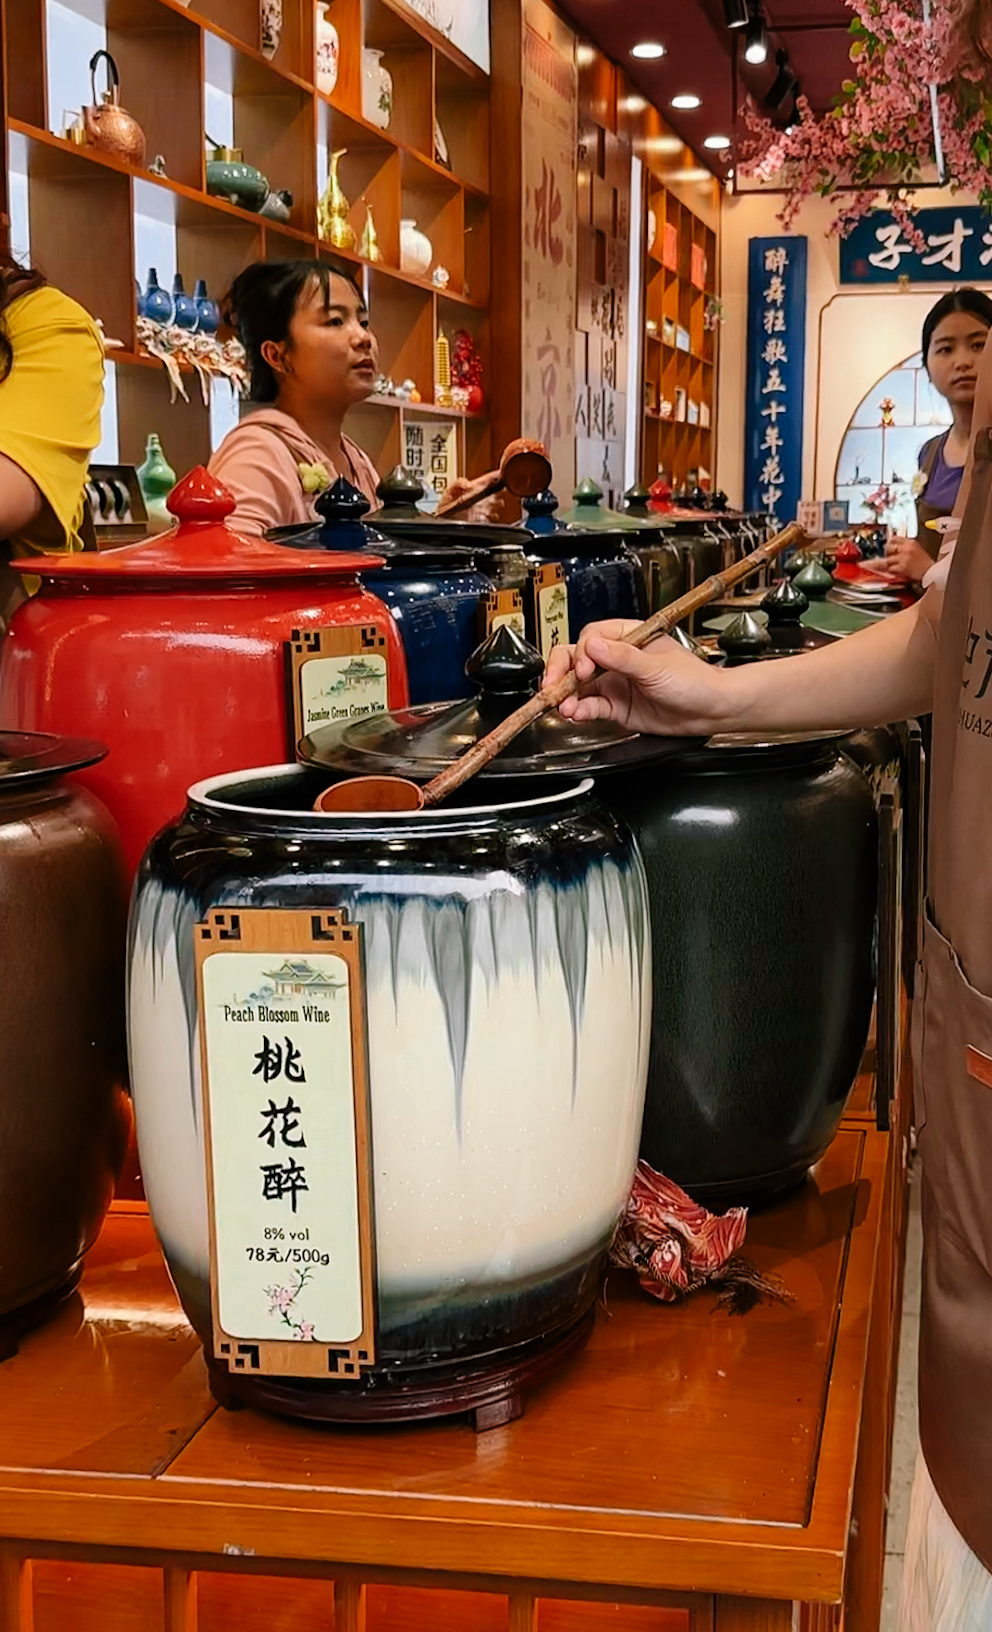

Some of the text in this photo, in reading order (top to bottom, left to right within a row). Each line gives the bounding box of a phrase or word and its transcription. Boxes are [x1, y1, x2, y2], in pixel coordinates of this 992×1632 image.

[307, 708, 330, 722] Jasmine
[331, 706, 348, 719] Green
[959, 706, 992, 742] HUAZ
[224, 1005, 331, 1023] Peach Blossom Wine
[252, 1034, 309, 1214] 桃花醉
[264, 1227, 310, 1241] 8% vol
[245, 1247, 330, 1266] 78元/500g
